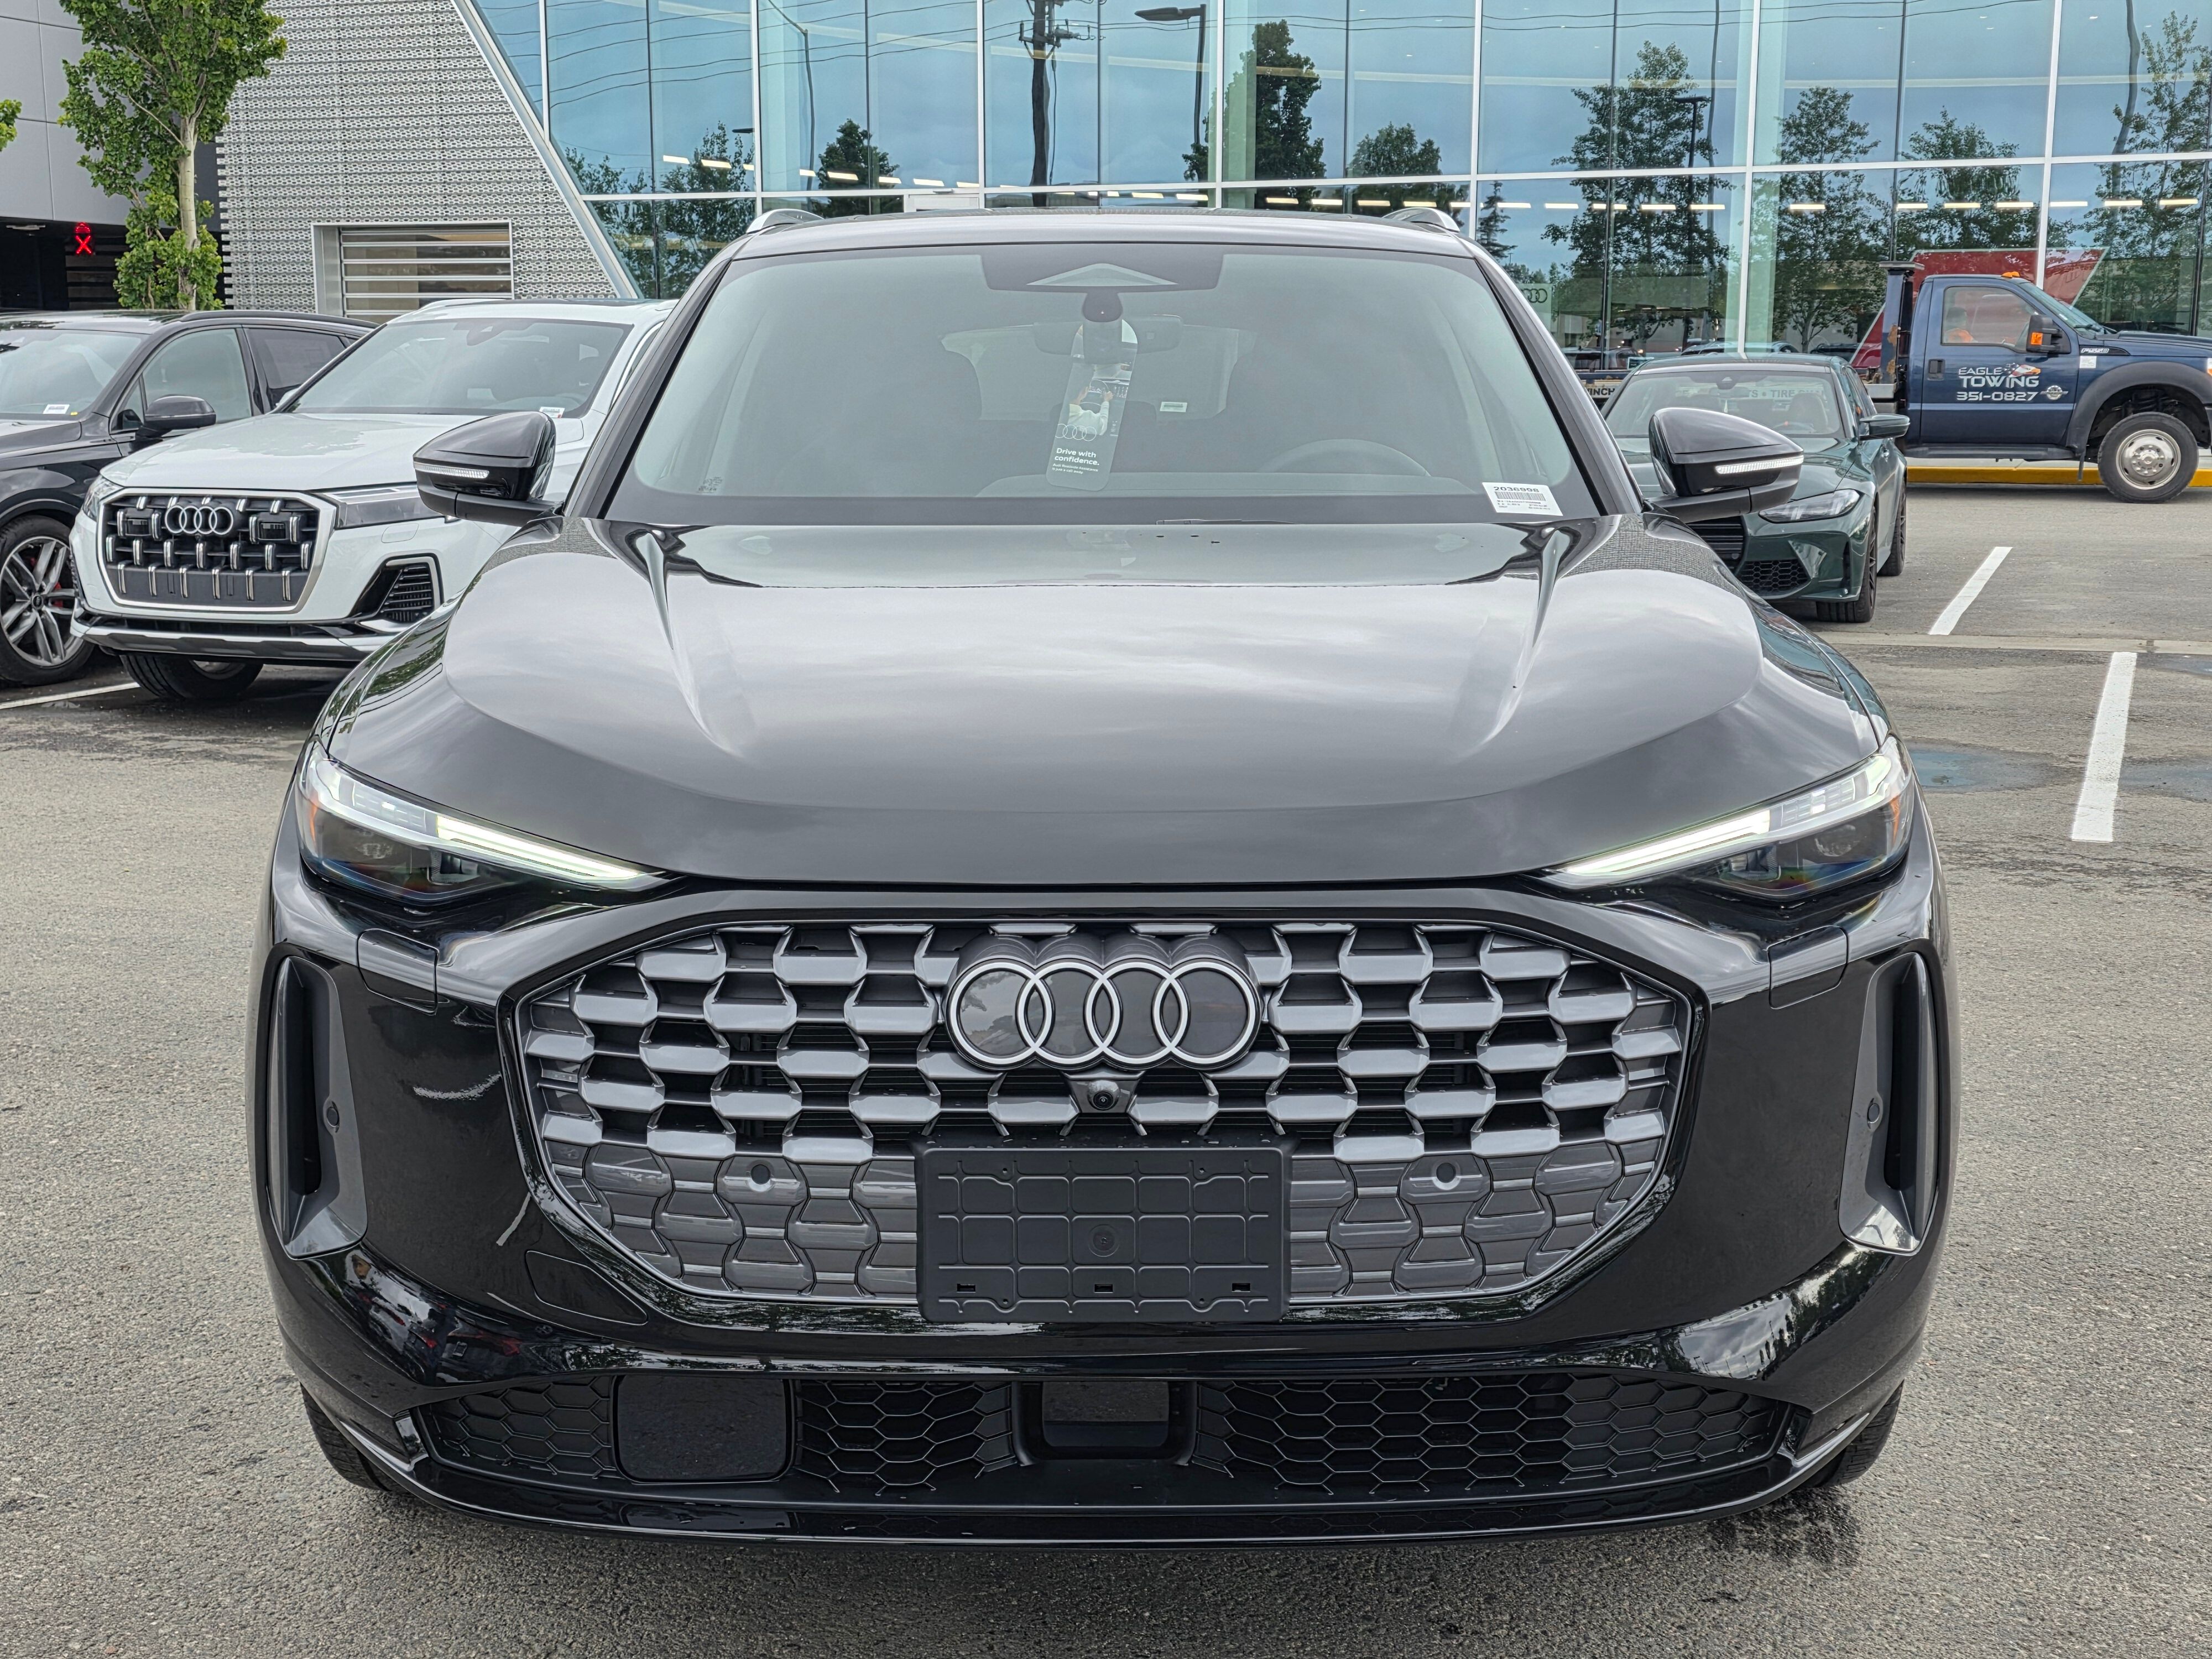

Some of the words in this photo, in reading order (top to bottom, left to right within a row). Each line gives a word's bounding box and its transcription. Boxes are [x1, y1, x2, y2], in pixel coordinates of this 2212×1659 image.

[1958, 375, 2039, 388] TOWING
[1957, 392, 2038, 401] 351-0827
[1055, 456, 1099, 466] confidence.
